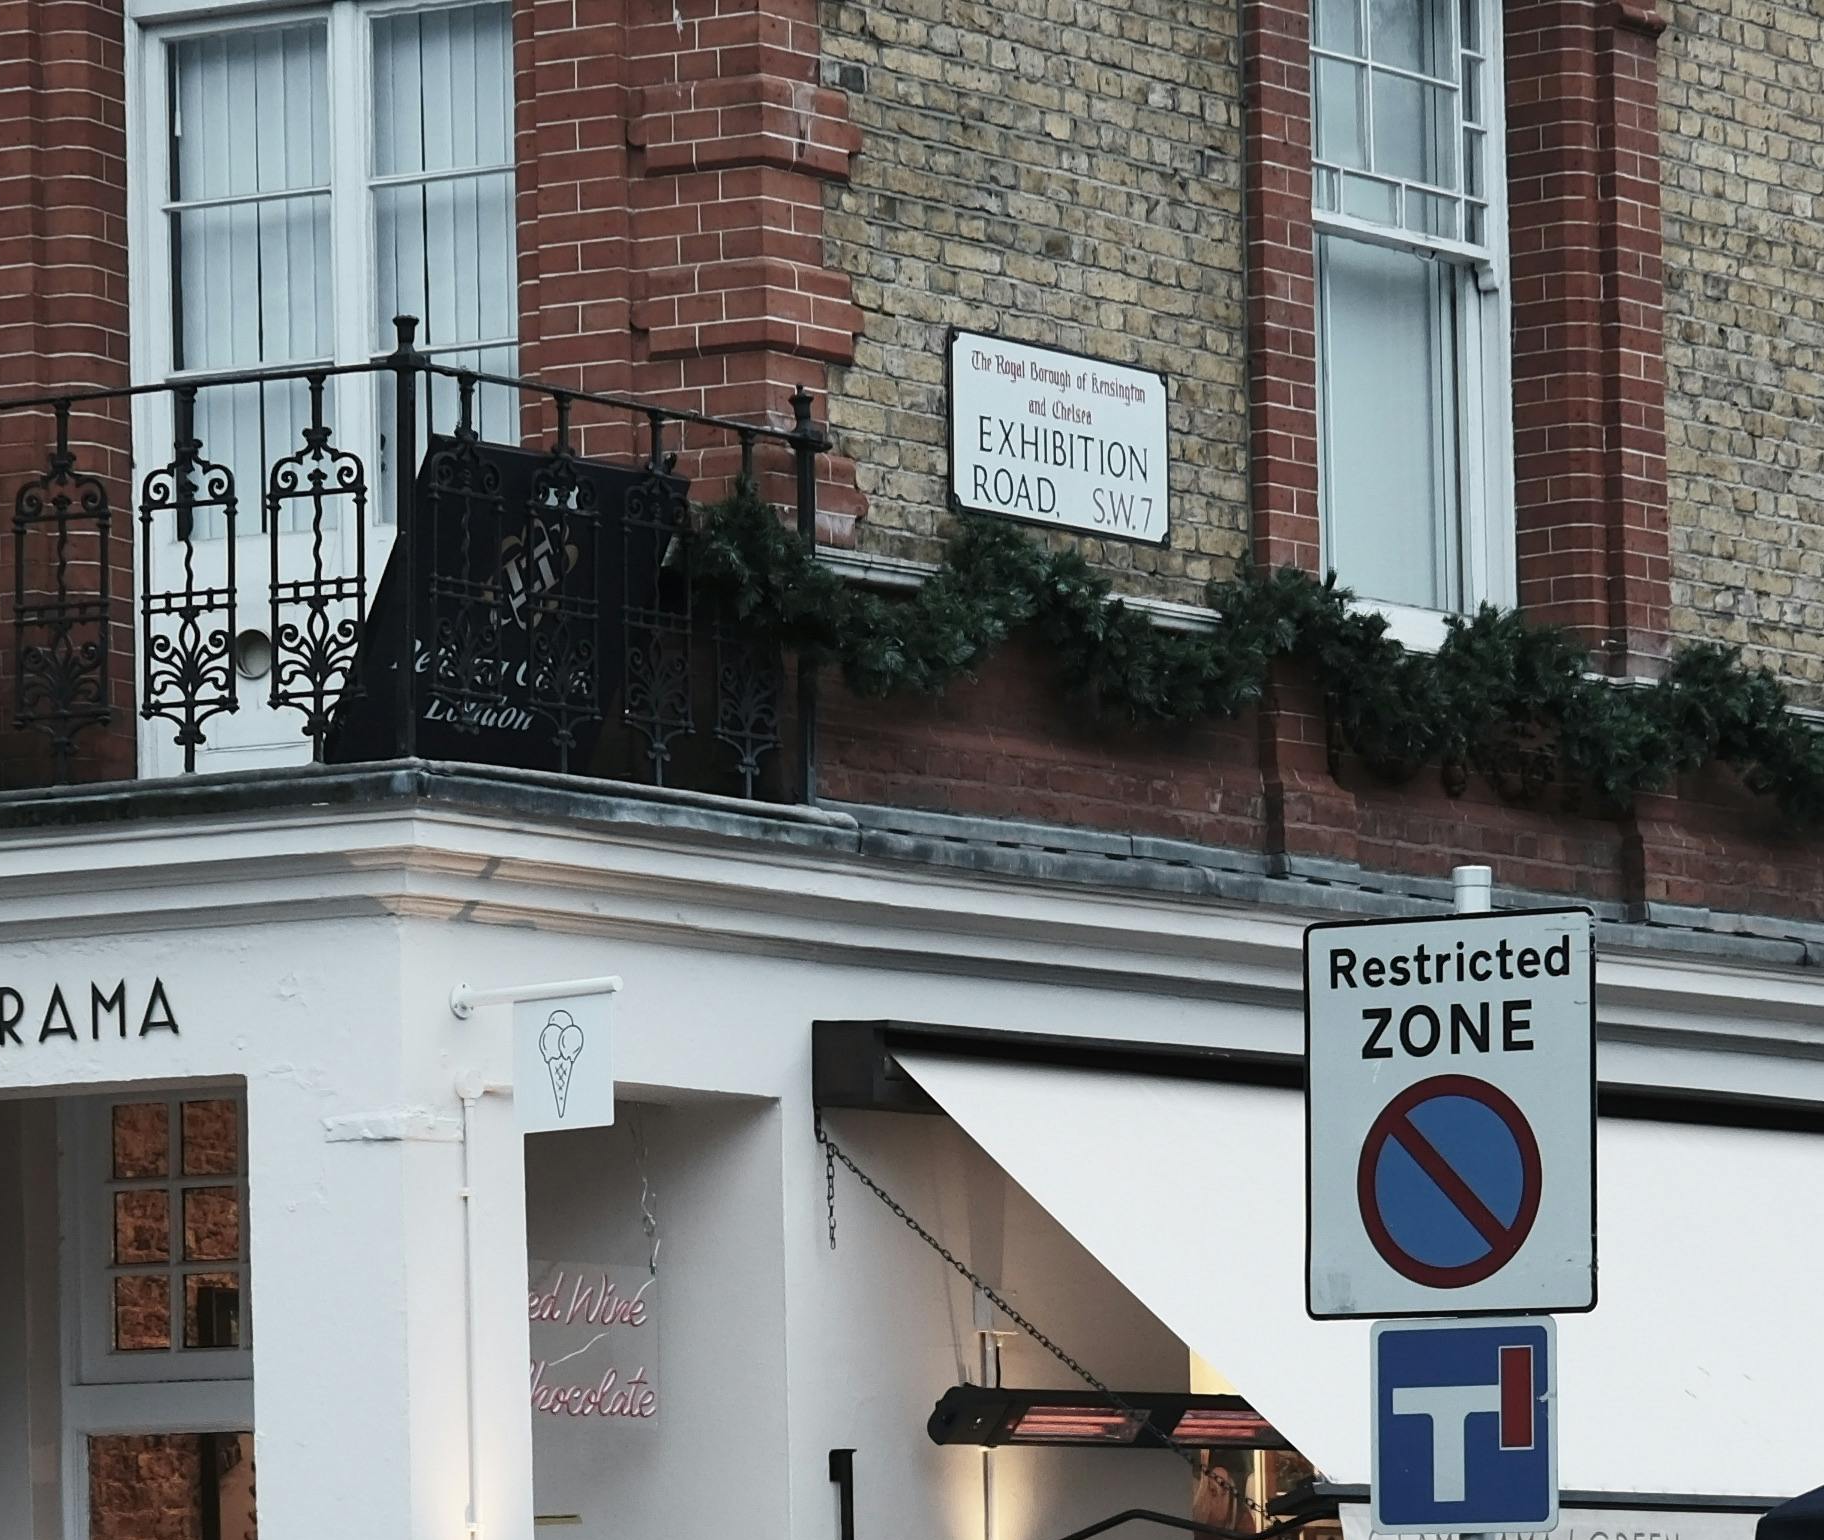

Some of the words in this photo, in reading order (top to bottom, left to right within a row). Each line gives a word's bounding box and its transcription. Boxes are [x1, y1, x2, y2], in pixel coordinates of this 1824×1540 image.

[972, 350, 992, 370] The
[995, 355, 1025, 383] Royal
[1031, 363, 1071, 393] Borough
[1077, 373, 1088, 392] of
[1092, 373, 1146, 406] Kensington
[1029, 397, 1046, 417] and
[1052, 400, 1093, 425] Chelsea
[979, 415, 1148, 483] EXHIBITION
[972, 464, 1061, 518] ROAD,
[1329, 935, 1570, 989] Restricted
[1362, 1000, 1534, 1059] ZONE
[528, 1272, 561, 1320] ed
[565, 1273, 647, 1326] Wine
[530, 1361, 656, 1417] hocolate
